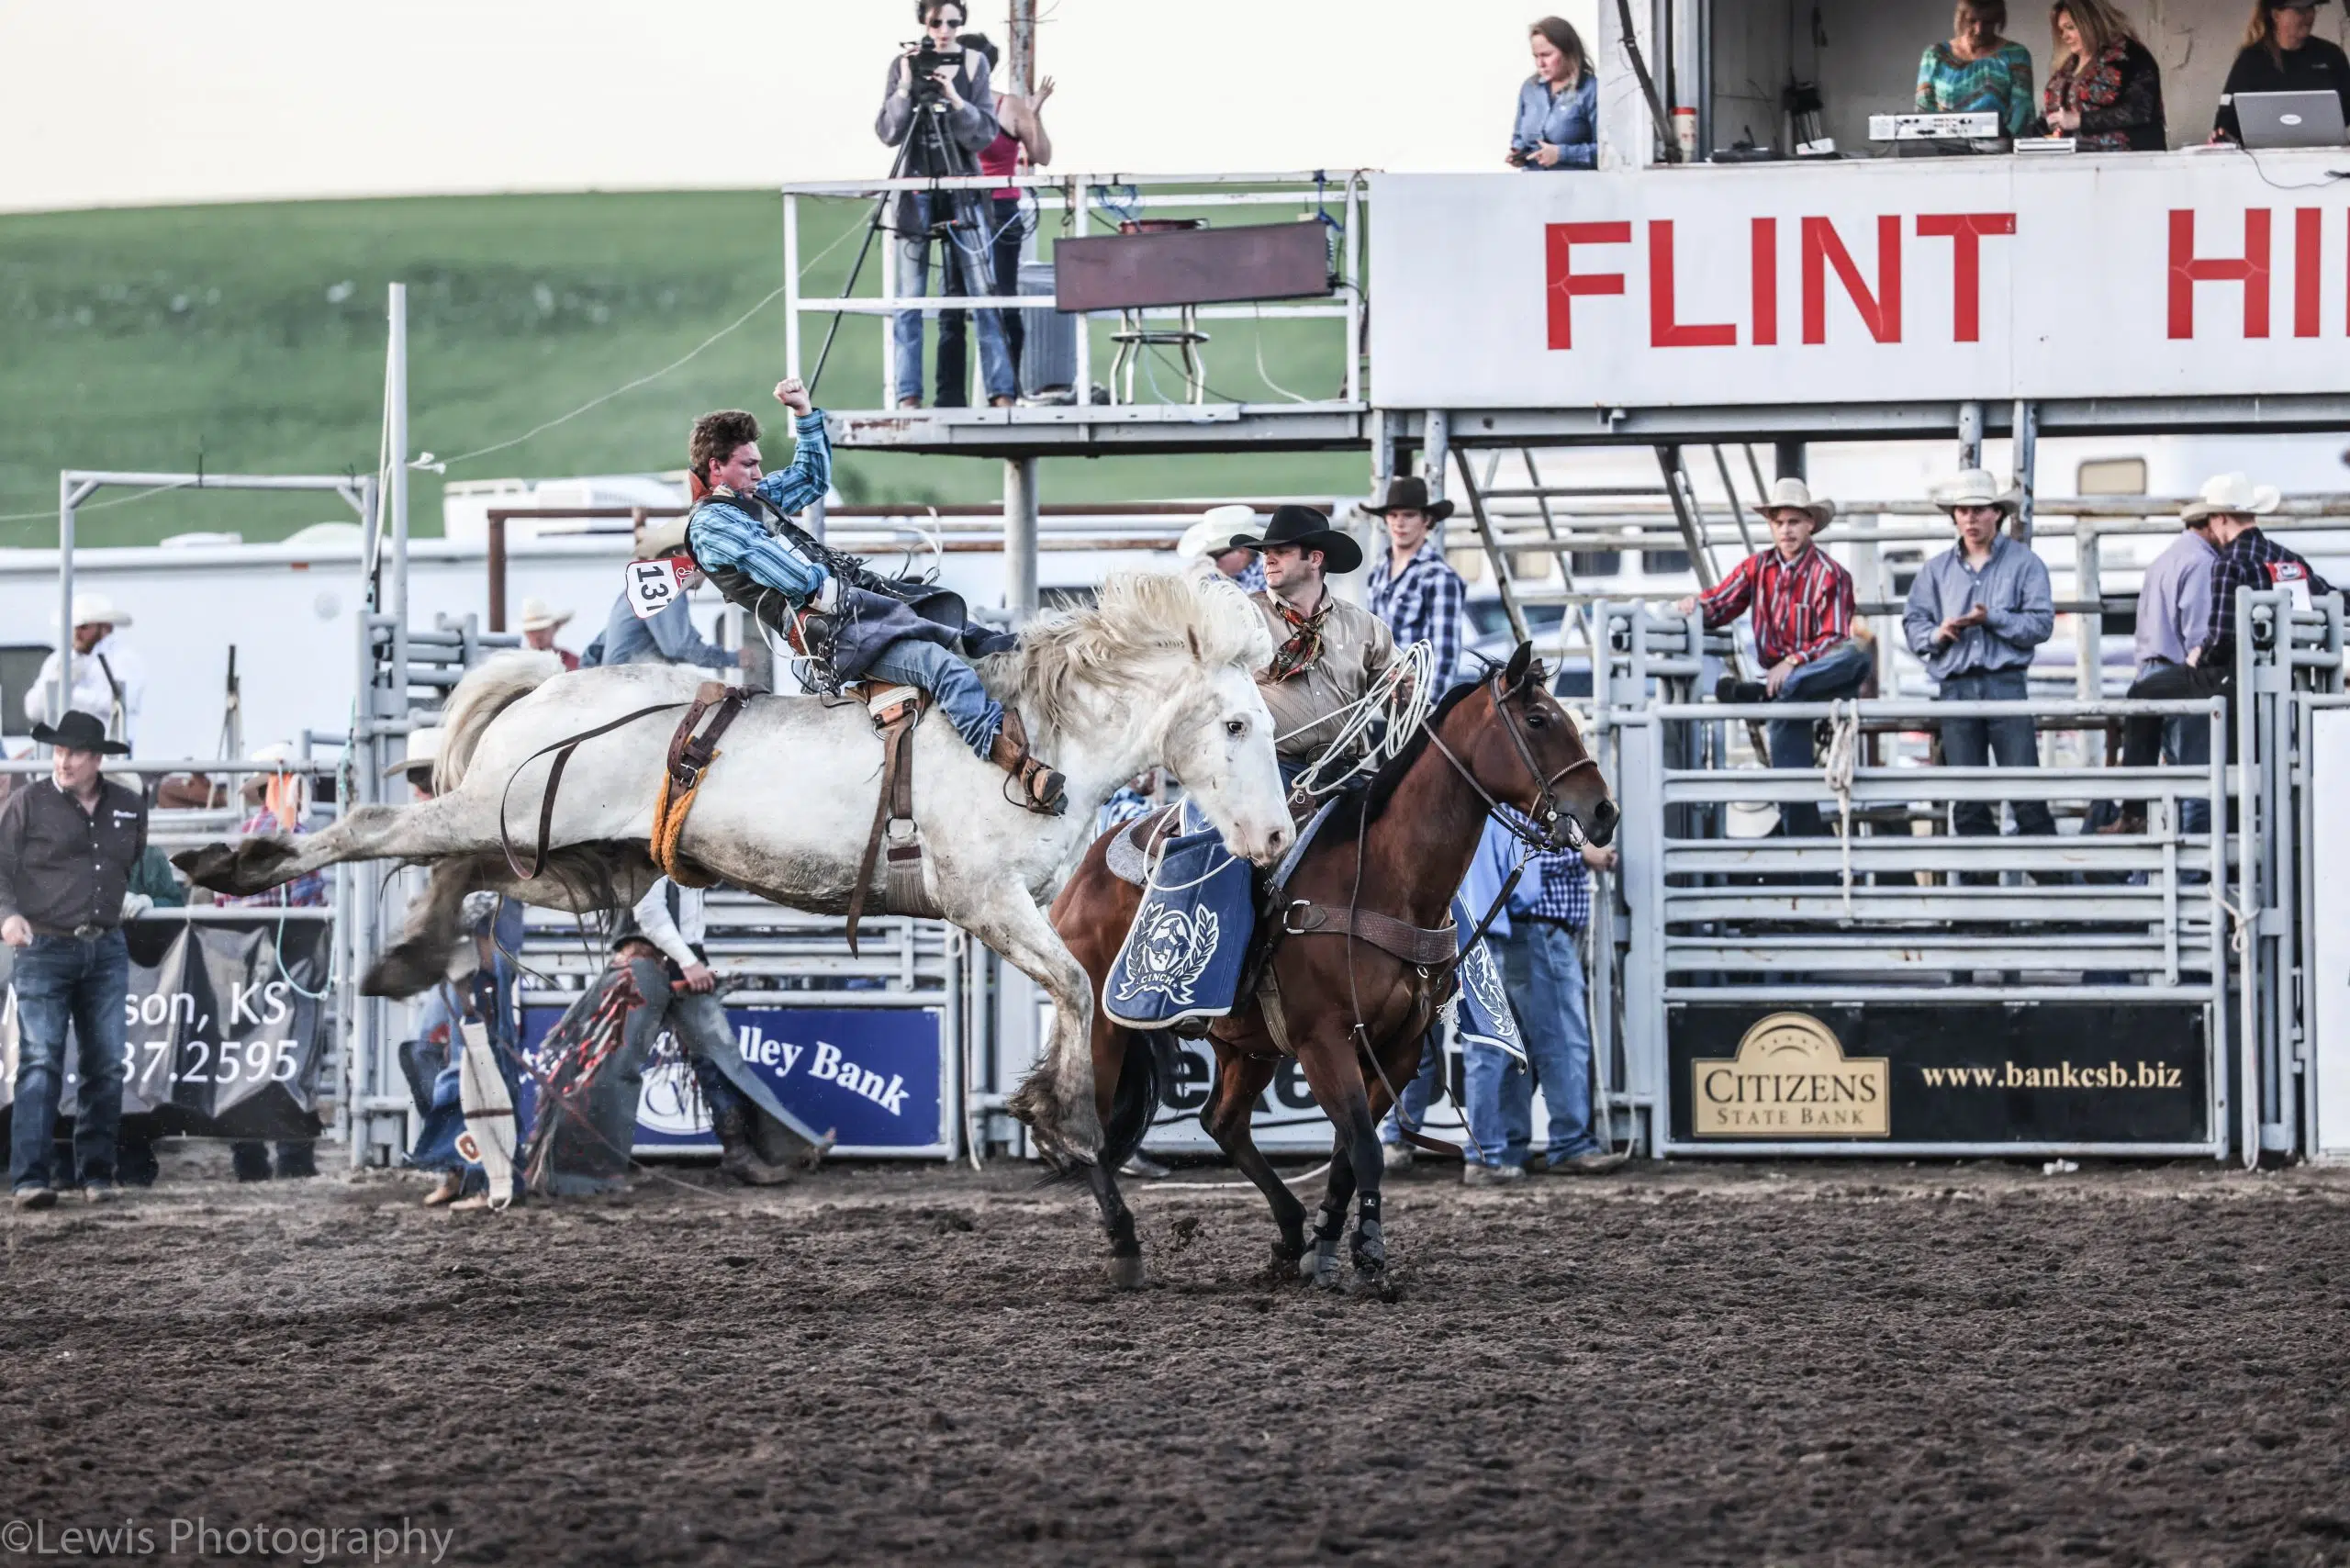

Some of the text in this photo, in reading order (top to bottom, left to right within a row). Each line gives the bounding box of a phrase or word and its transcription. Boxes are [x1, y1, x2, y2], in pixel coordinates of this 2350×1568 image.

[1545, 207, 2350, 351] FLINT HI
[1140, 973, 1174, 985] CINCH
[230, 980, 286, 1025] KS
[739, 1025, 804, 1078] lley
[808, 1040, 911, 1117] Bank
[1921, 1060, 2183, 1087] www.bankcsb.biz
